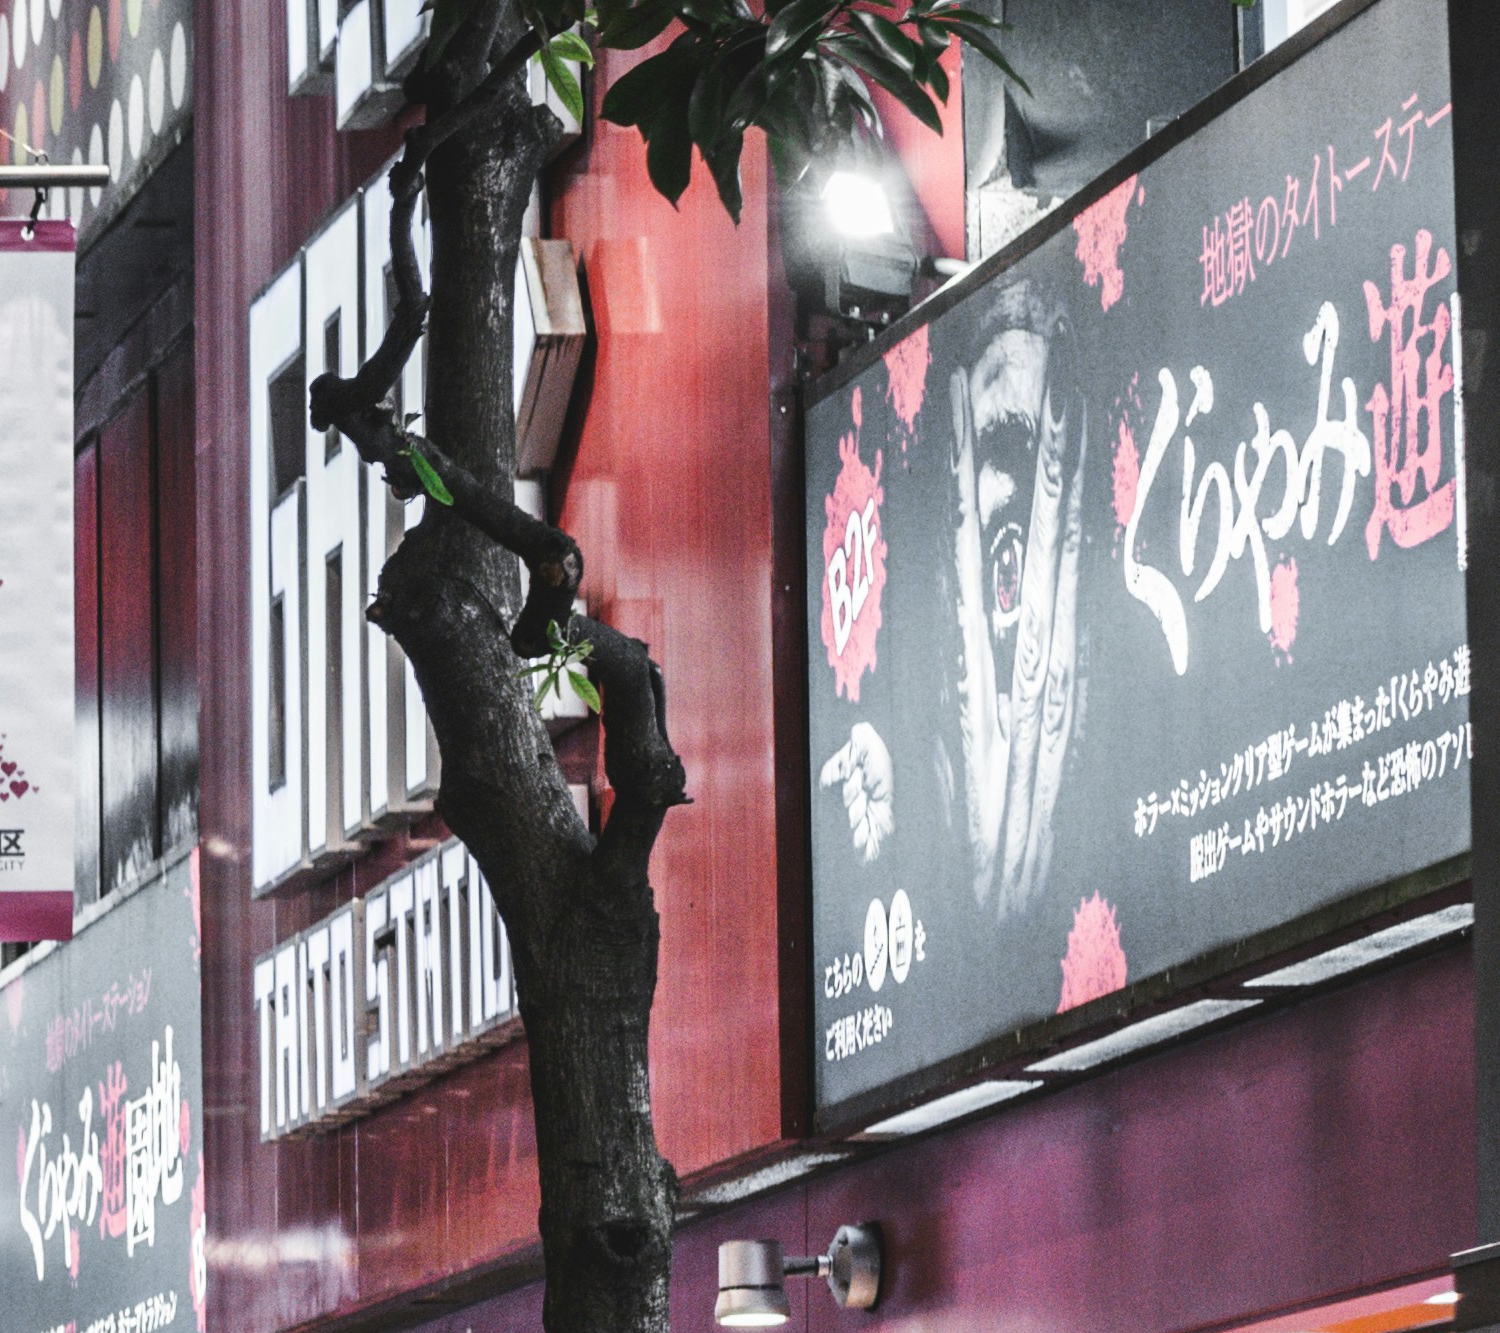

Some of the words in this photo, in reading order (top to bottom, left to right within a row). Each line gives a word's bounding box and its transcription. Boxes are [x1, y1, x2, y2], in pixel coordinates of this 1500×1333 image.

[828, 498, 876, 656] B2F
[1124, 230, 1467, 674] くらやみ遊
[253, 908, 357, 1140] TAITO
[364, 843, 520, 1083] STATIO
[824, 950, 863, 999] こちらの
[20, 1025, 184, 1282] くらやみ遊園地
